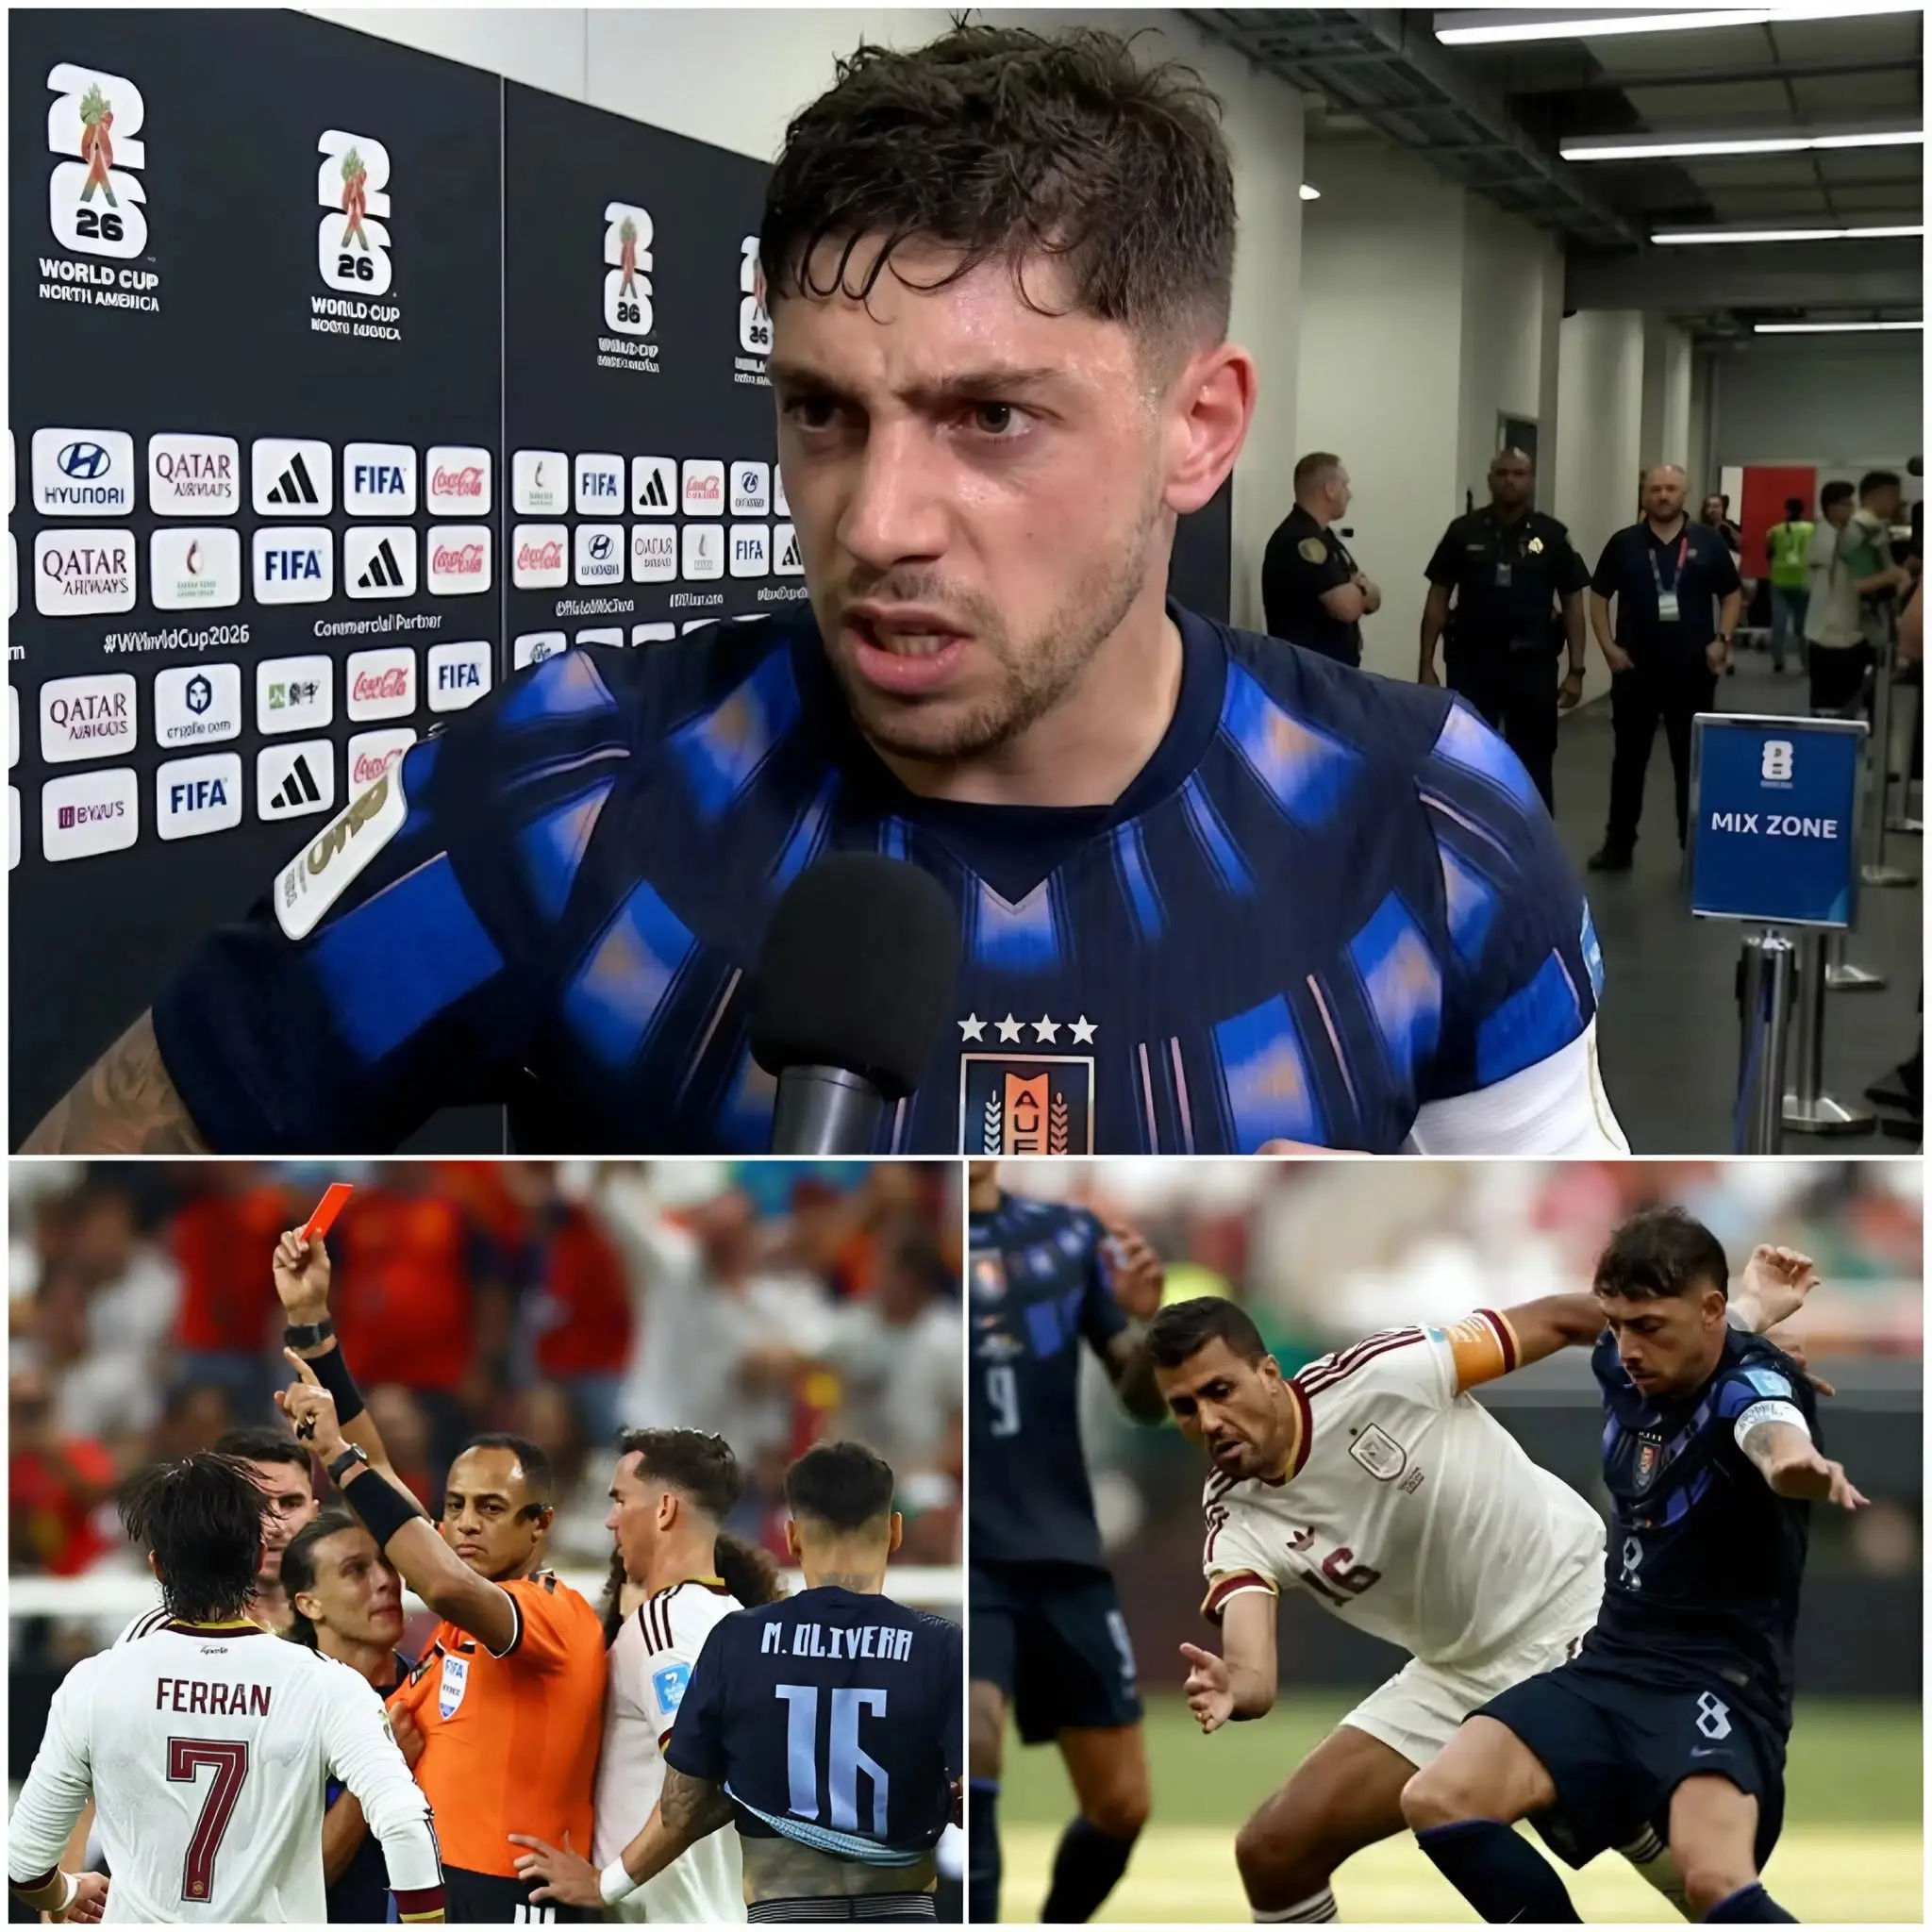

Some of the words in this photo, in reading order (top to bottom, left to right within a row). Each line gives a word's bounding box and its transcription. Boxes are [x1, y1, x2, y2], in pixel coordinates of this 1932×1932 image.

[75, 208, 125, 242] 26
[39, 258, 115, 286] WORLD
[119, 269, 159, 291] CUP
[337, 254, 375, 282] 26
[156, 452, 231, 483] QATAR
[355, 465, 405, 494] FIFA
[582, 472, 617, 497] FIFA
[42, 549, 127, 582] QATAR
[265, 550, 322, 581] FIFA
[736, 539, 763, 560] FIFA
[438, 663, 480, 691] FIFA
[50, 692, 127, 727] QATAR
[170, 778, 227, 814] FIFA
[1711, 812, 1758, 834] MIX
[1766, 815, 1838, 839] ZONE
[985, 1366, 1020, 1438] 9
[760, 1622, 787, 1654] M.
[792, 1623, 913, 1662] OLIVERA
[157, 1677, 272, 1717] FERRAN
[1696, 1690, 1732, 1740] 8
[775, 1684, 889, 1837] 16
[166, 1736, 249, 1904] 7
